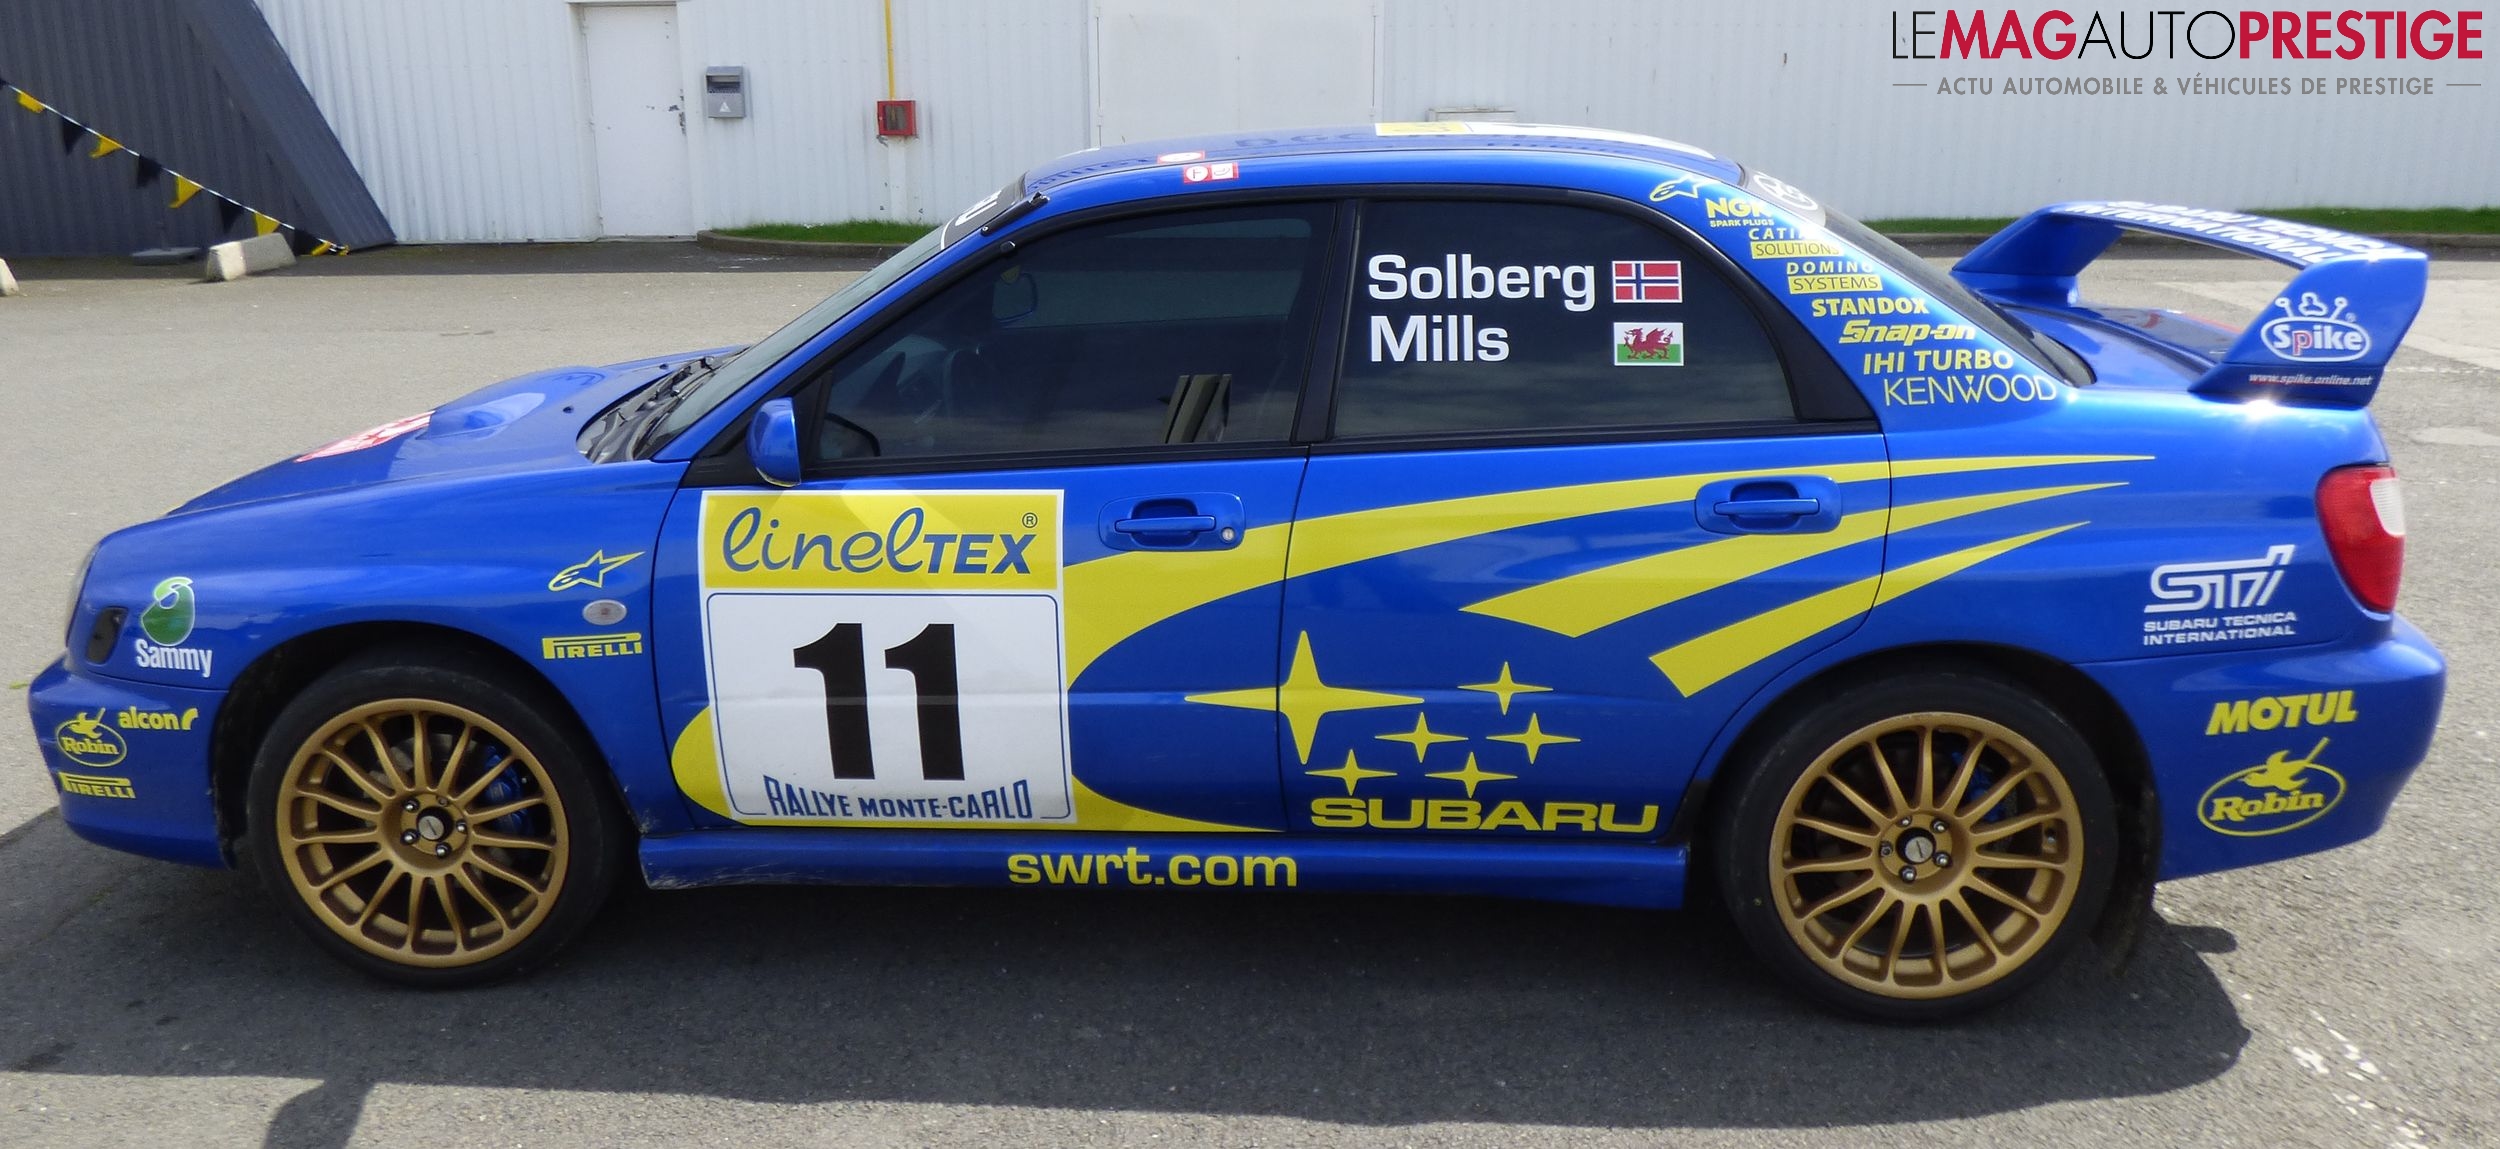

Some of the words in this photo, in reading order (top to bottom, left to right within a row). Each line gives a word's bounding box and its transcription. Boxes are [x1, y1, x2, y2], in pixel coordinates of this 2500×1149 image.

[1705, 198, 1773, 218] NGK
[1710, 219, 1740, 228] SPARK
[1743, 218, 1774, 227] PLUGS
[1755, 242, 1840, 257] SOLUTIONS
[1787, 261, 1873, 275] DOMINO
[1368, 253, 1596, 312] Solberg
[1793, 276, 1879, 291] SYSTEMS
[1812, 297, 1930, 317] STANDOX
[1370, 314, 1510, 362] Mills
[1839, 319, 1976, 346] Snap-on
[2273, 323, 2364, 356] Spike
[1863, 352, 1905, 375] IHI
[1914, 350, 2014, 371] TURBO
[1884, 374, 2057, 406] KENWOOD
[2144, 617, 2218, 632] SUBARU
[2223, 611, 2297, 627] TECNICA
[2144, 624, 2296, 646] INTERNATIONAL
[135, 638, 213, 678] Sammy
[542, 632, 643, 660] PIRELLI
[793, 622, 965, 781] 11
[2205, 690, 2358, 736] MOTUL
[61, 736, 119, 754] Robin
[58, 771, 136, 799] PIRELLI
[763, 774, 850, 817] RALLYE
[859, 779, 1033, 820] MONTE-CARLO
[1310, 797, 1659, 834] SUBARU
[2208, 790, 2325, 823] Robin
[1007, 846, 1298, 888] swrt.com
